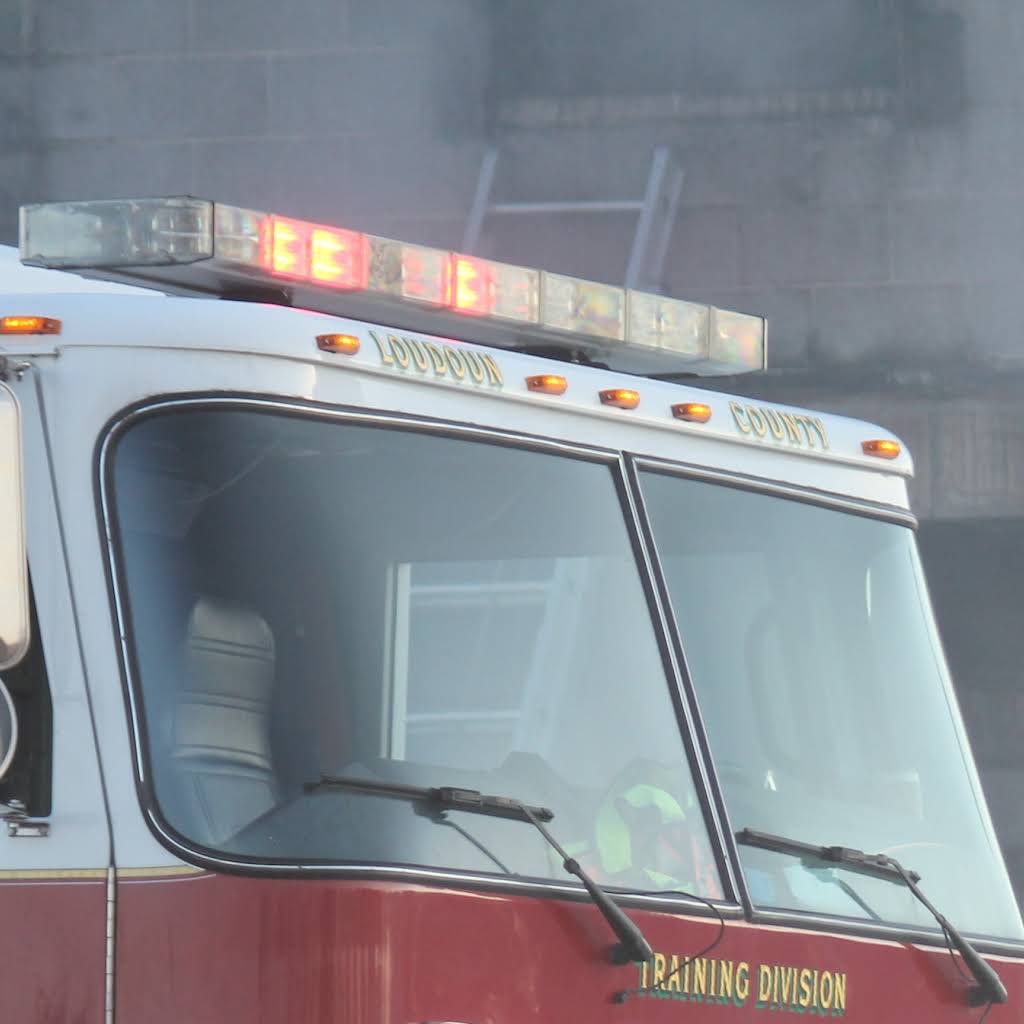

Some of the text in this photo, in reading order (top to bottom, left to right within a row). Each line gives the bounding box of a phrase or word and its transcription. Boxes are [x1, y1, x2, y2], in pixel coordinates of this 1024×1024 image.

[369, 330, 503, 385] LOUDOUN
[729, 401, 829, 449] COUNTY
[638, 952, 846, 1010] TRAINING DIVISION
